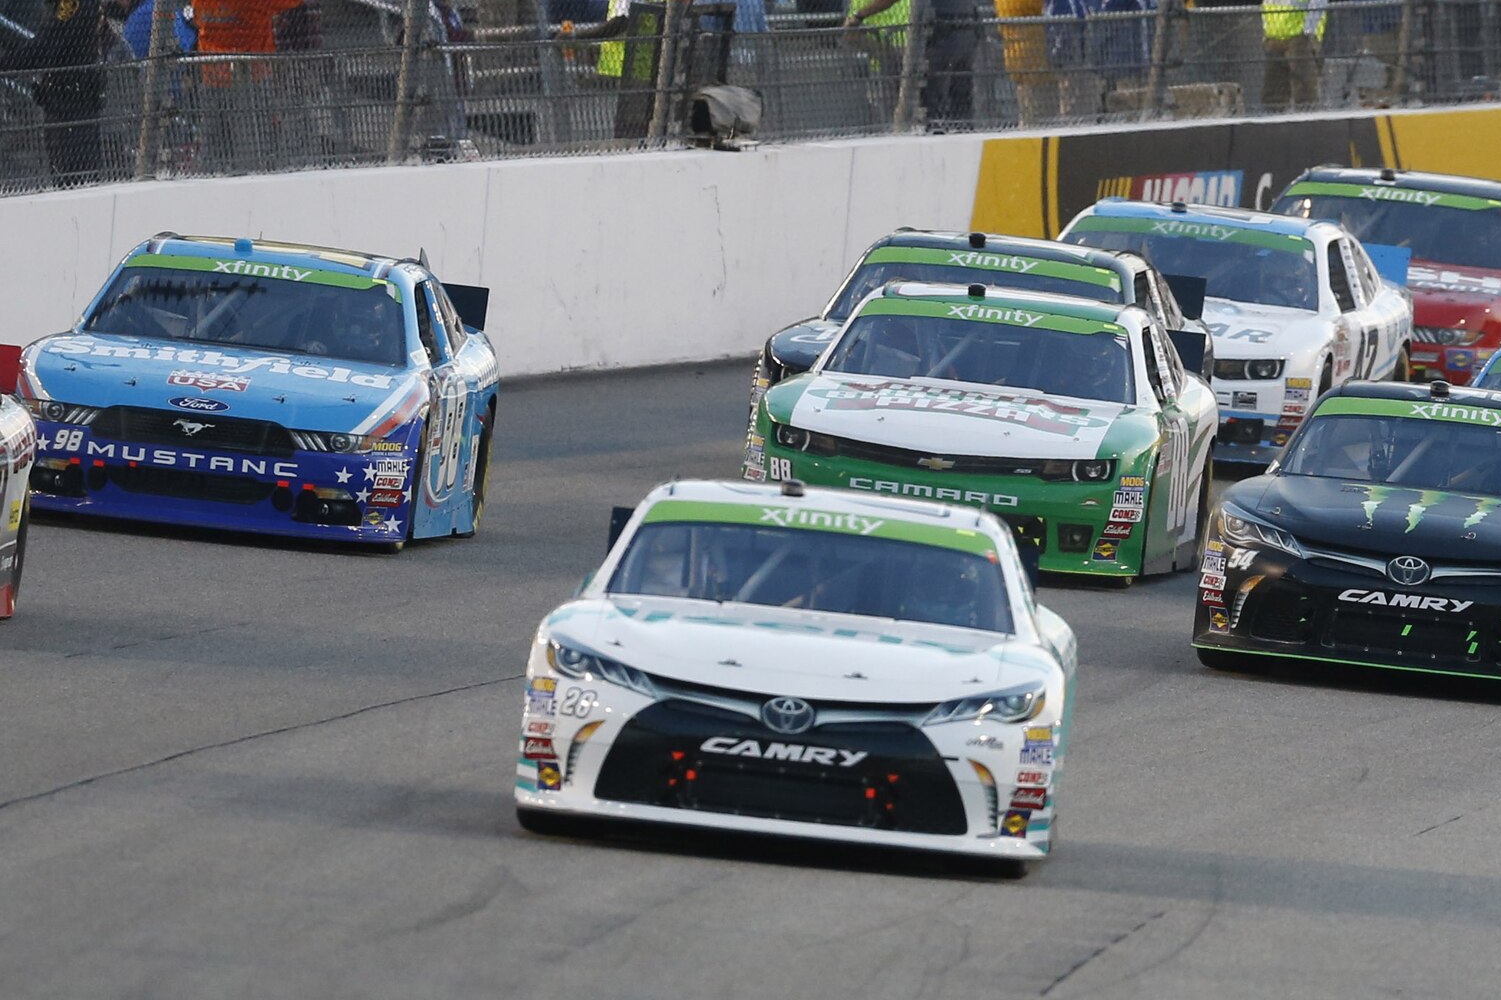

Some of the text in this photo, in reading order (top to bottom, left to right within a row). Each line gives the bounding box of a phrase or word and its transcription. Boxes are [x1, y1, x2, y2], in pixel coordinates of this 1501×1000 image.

[1359, 185, 1443, 206] xfinity
[1152, 220, 1238, 241] xfinity
[211, 258, 313, 282] xfinity
[947, 250, 1040, 274] xfinity
[946, 303, 1045, 328] xfinity
[48, 337, 394, 390] Smithfield
[170, 374, 243, 393] USA
[178, 398, 221, 412] Ford
[876, 396, 1031, 424] PIZZA
[53, 429, 84, 451] 98
[371, 441, 402, 452] MOOG
[377, 460, 408, 473] MAHLE
[770, 456, 792, 480] 88
[848, 476, 1020, 508] CAMARO
[1120, 476, 1145, 487] MOOG
[1114, 491, 1143, 505] MAHLE
[760, 504, 886, 536] xfinity
[1227, 547, 1261, 571] 54
[1337, 587, 1475, 614] CAMRY
[699, 736, 869, 769] CAMRY
